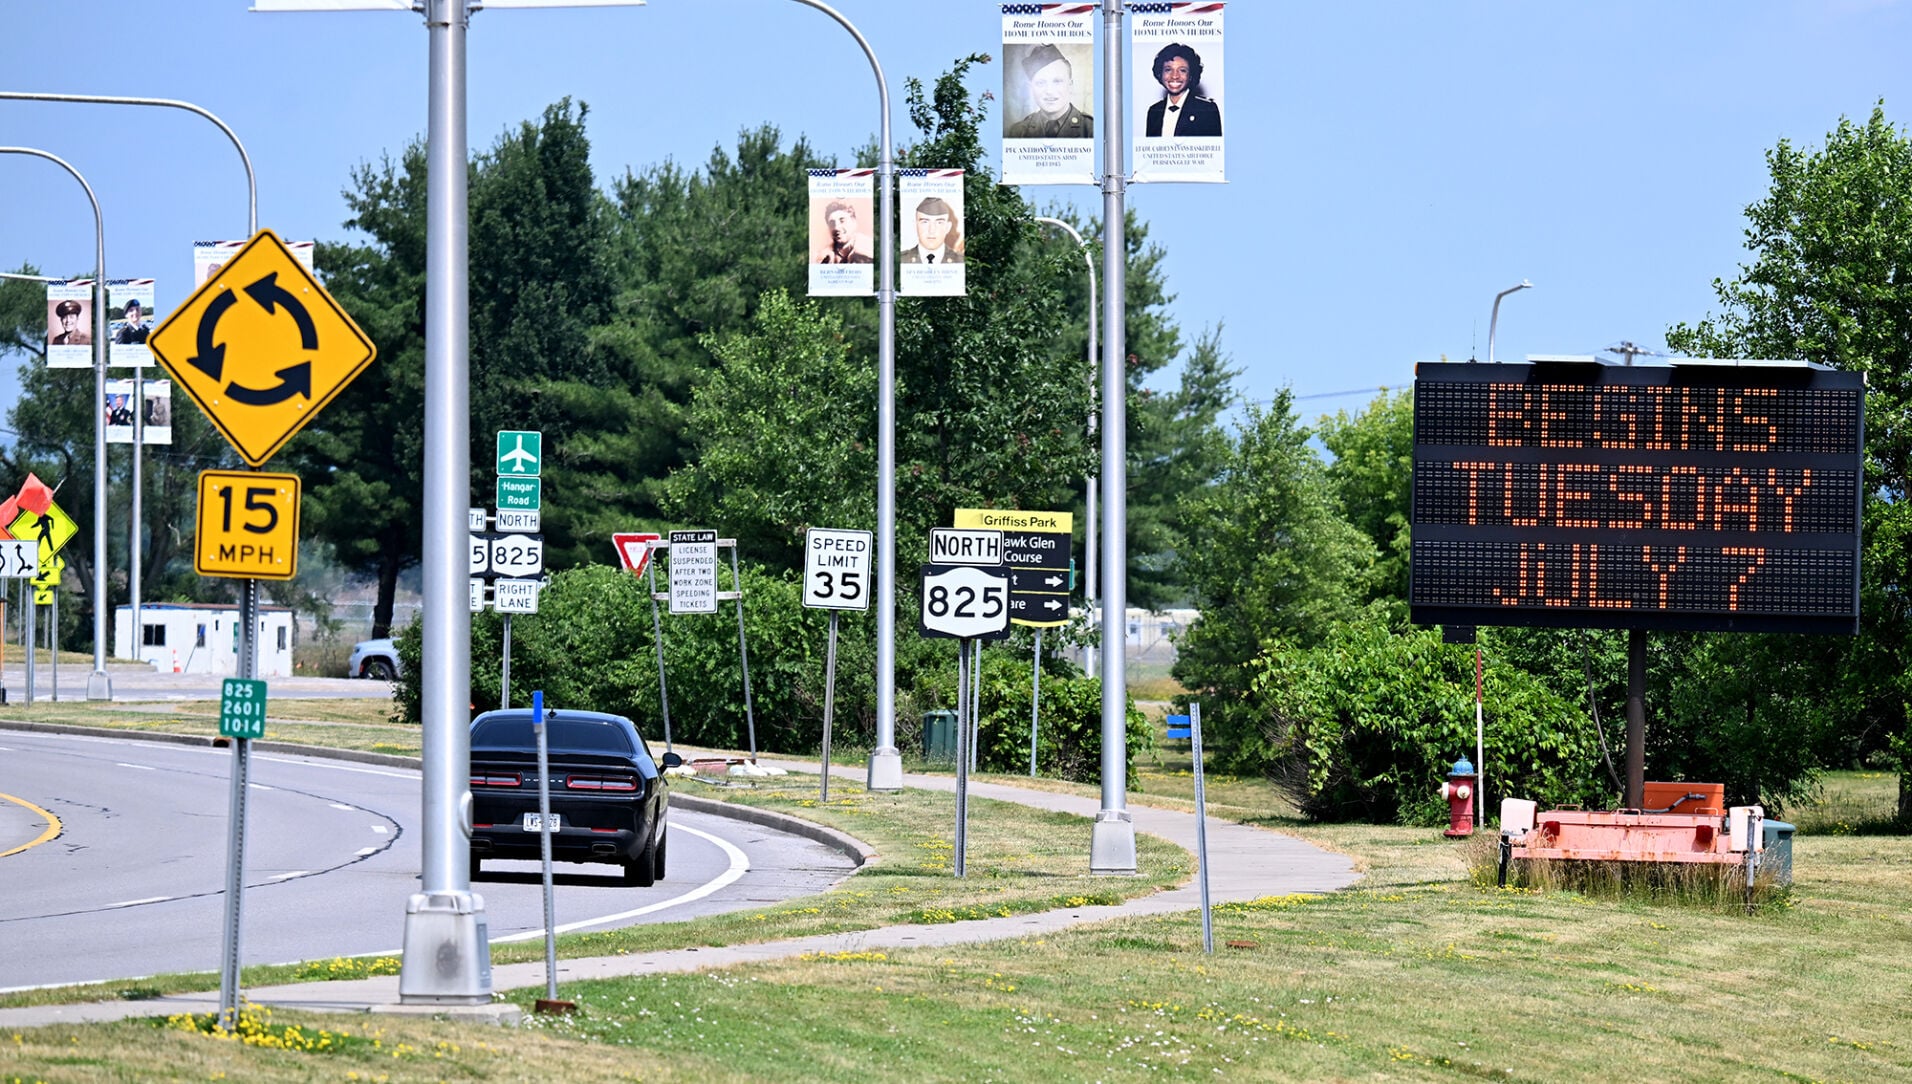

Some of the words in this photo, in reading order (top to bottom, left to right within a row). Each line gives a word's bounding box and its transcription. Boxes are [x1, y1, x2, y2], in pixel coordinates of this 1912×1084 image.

[1489, 383, 1777, 452] BEGINS
[503, 482, 534, 493] Hangar
[507, 496, 530, 505] Road
[1452, 462, 1812, 532] TUESDAY
[218, 486, 279, 534] 15
[500, 514, 537, 527] NORTH
[984, 516, 1027, 526] Griffiss
[1030, 517, 1056, 528] Park
[813, 538, 866, 552] SPEED
[934, 534, 999, 557] NORTH
[1004, 536, 1027, 548] awk
[1029, 537, 1055, 549] Glen
[219, 544, 274, 564] MPH
[495, 547, 539, 565] 825
[818, 555, 859, 568] LIMIT
[1004, 551, 1042, 563] Course
[1493, 543, 1686, 609] JULY
[1722, 548, 1764, 611] 7
[500, 585, 532, 595] RIGHT
[813, 571, 860, 600] 35
[500, 599, 531, 608] LANE
[928, 585, 1003, 619] 825
[224, 683, 253, 698] 825
[224, 700, 260, 716] 2601
[225, 718, 260, 734] 1014
